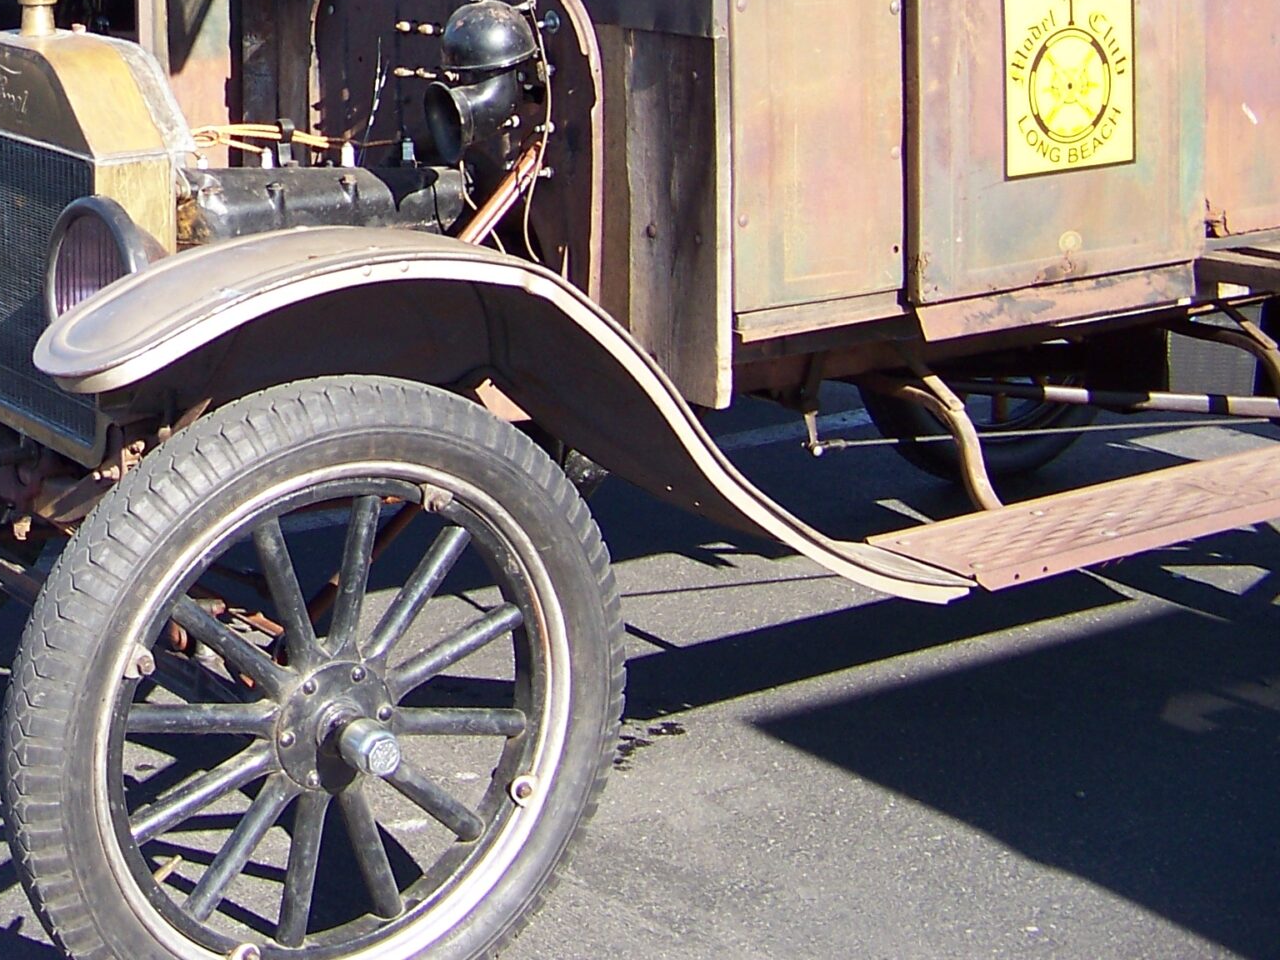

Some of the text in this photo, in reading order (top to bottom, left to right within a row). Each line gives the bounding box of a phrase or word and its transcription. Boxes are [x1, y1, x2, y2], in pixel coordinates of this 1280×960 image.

[1088, 12, 1127, 76] Club
[1018, 107, 1122, 164] LONG BEACH
